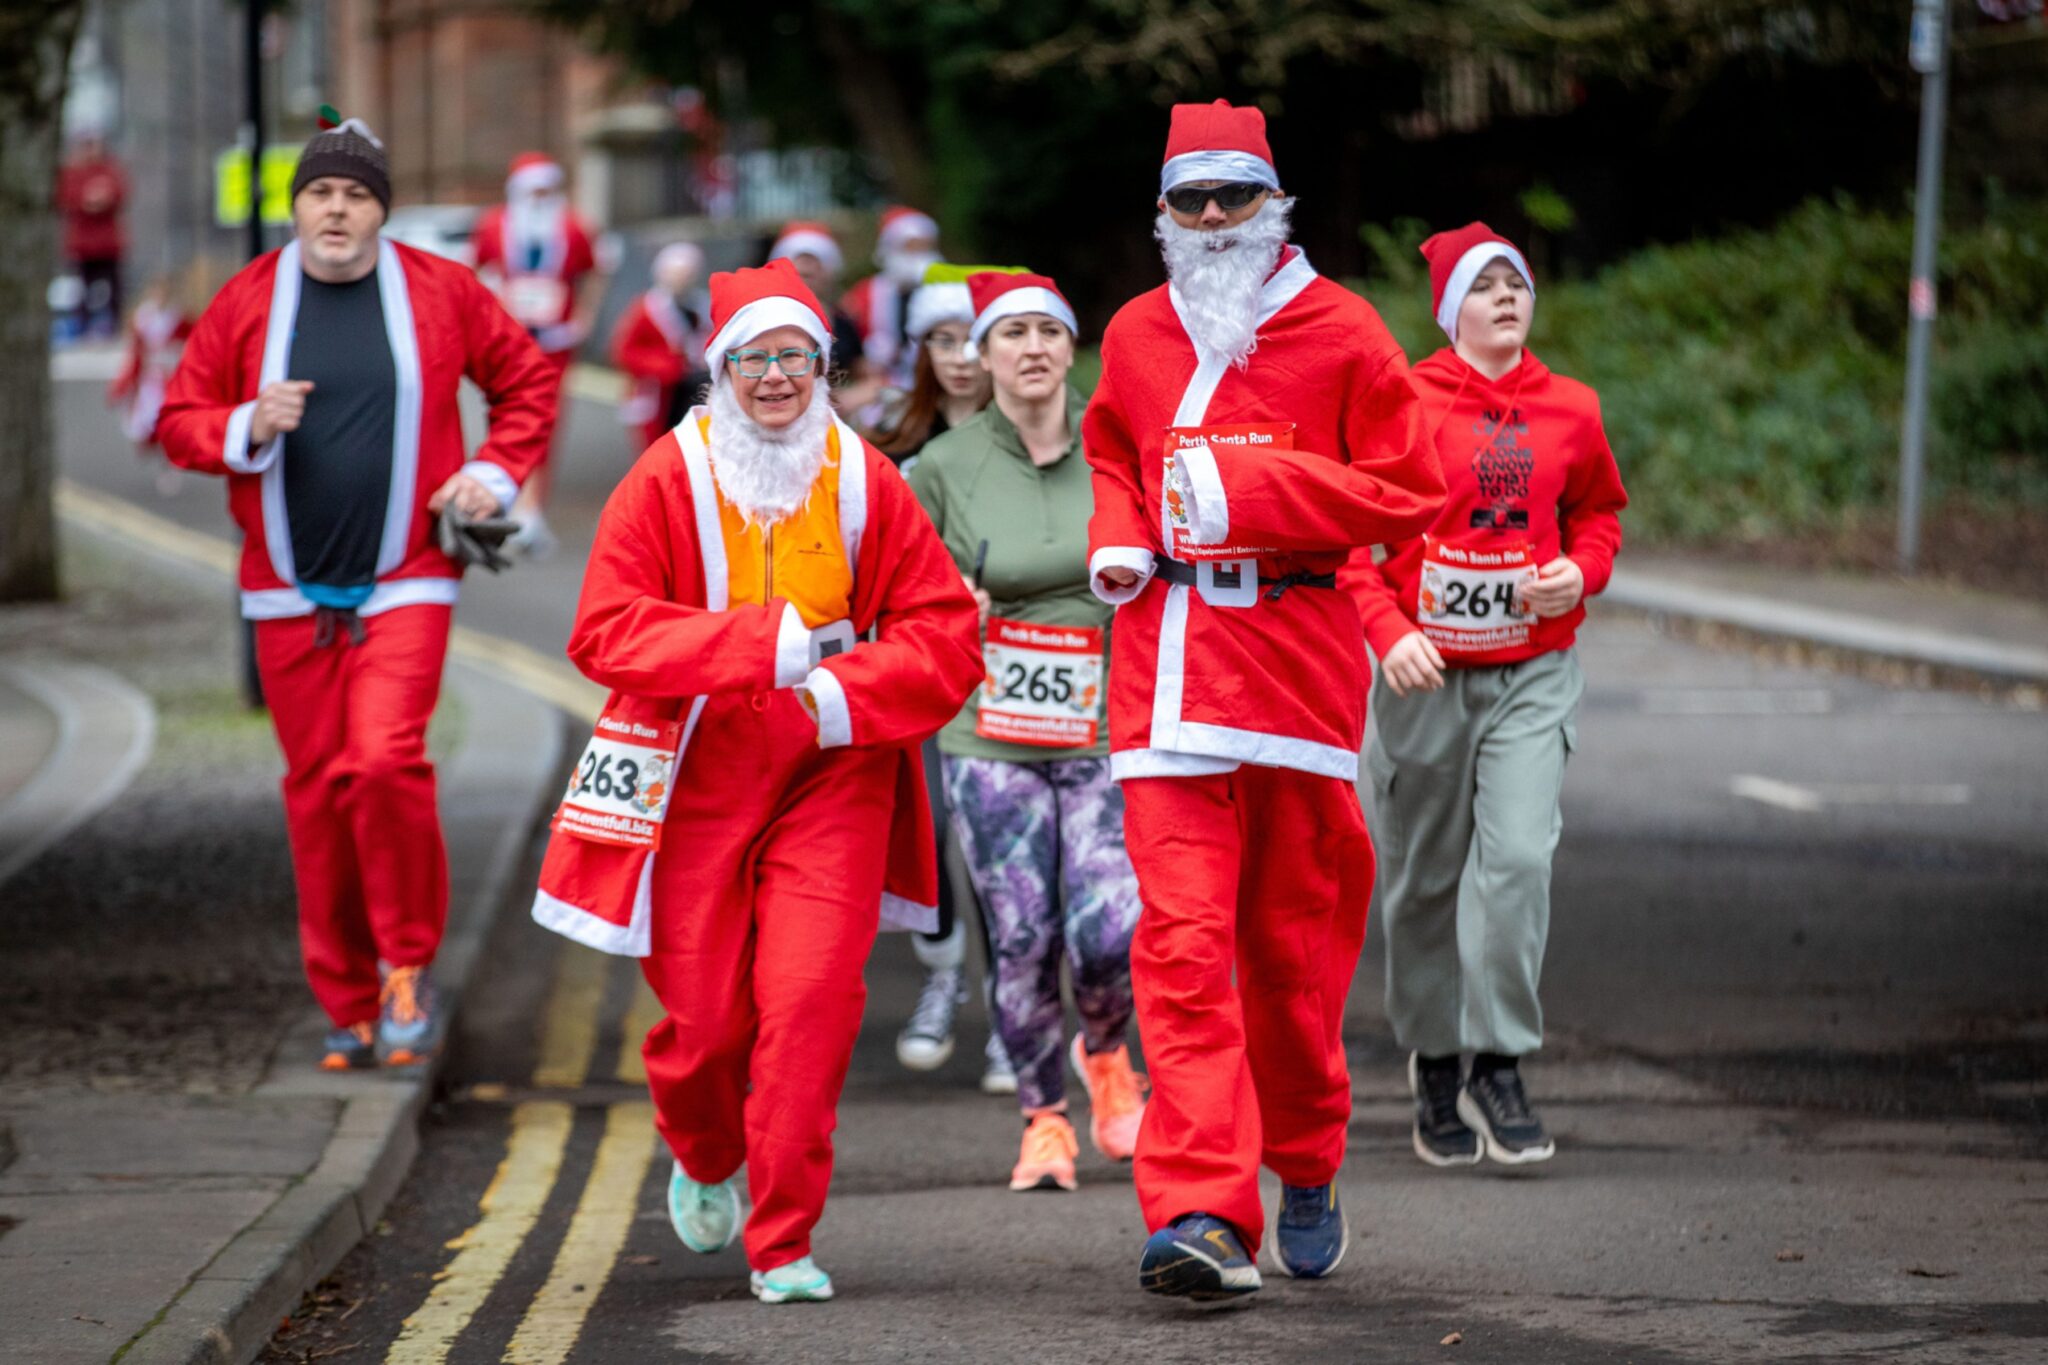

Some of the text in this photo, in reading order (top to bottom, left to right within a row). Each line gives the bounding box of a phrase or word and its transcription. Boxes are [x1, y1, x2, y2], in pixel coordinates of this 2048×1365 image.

[1179, 432, 1273, 447] Perth Santa Run
[1480, 459, 1534, 472] KNOW
[1480, 485, 1529, 498] TO DO
[1439, 544, 1525, 565] Perth Santa Run
[1446, 581, 1514, 618] 264
[1005, 662, 1073, 704] 265
[632, 722, 659, 739] Run
[579, 750, 639, 802] 263
